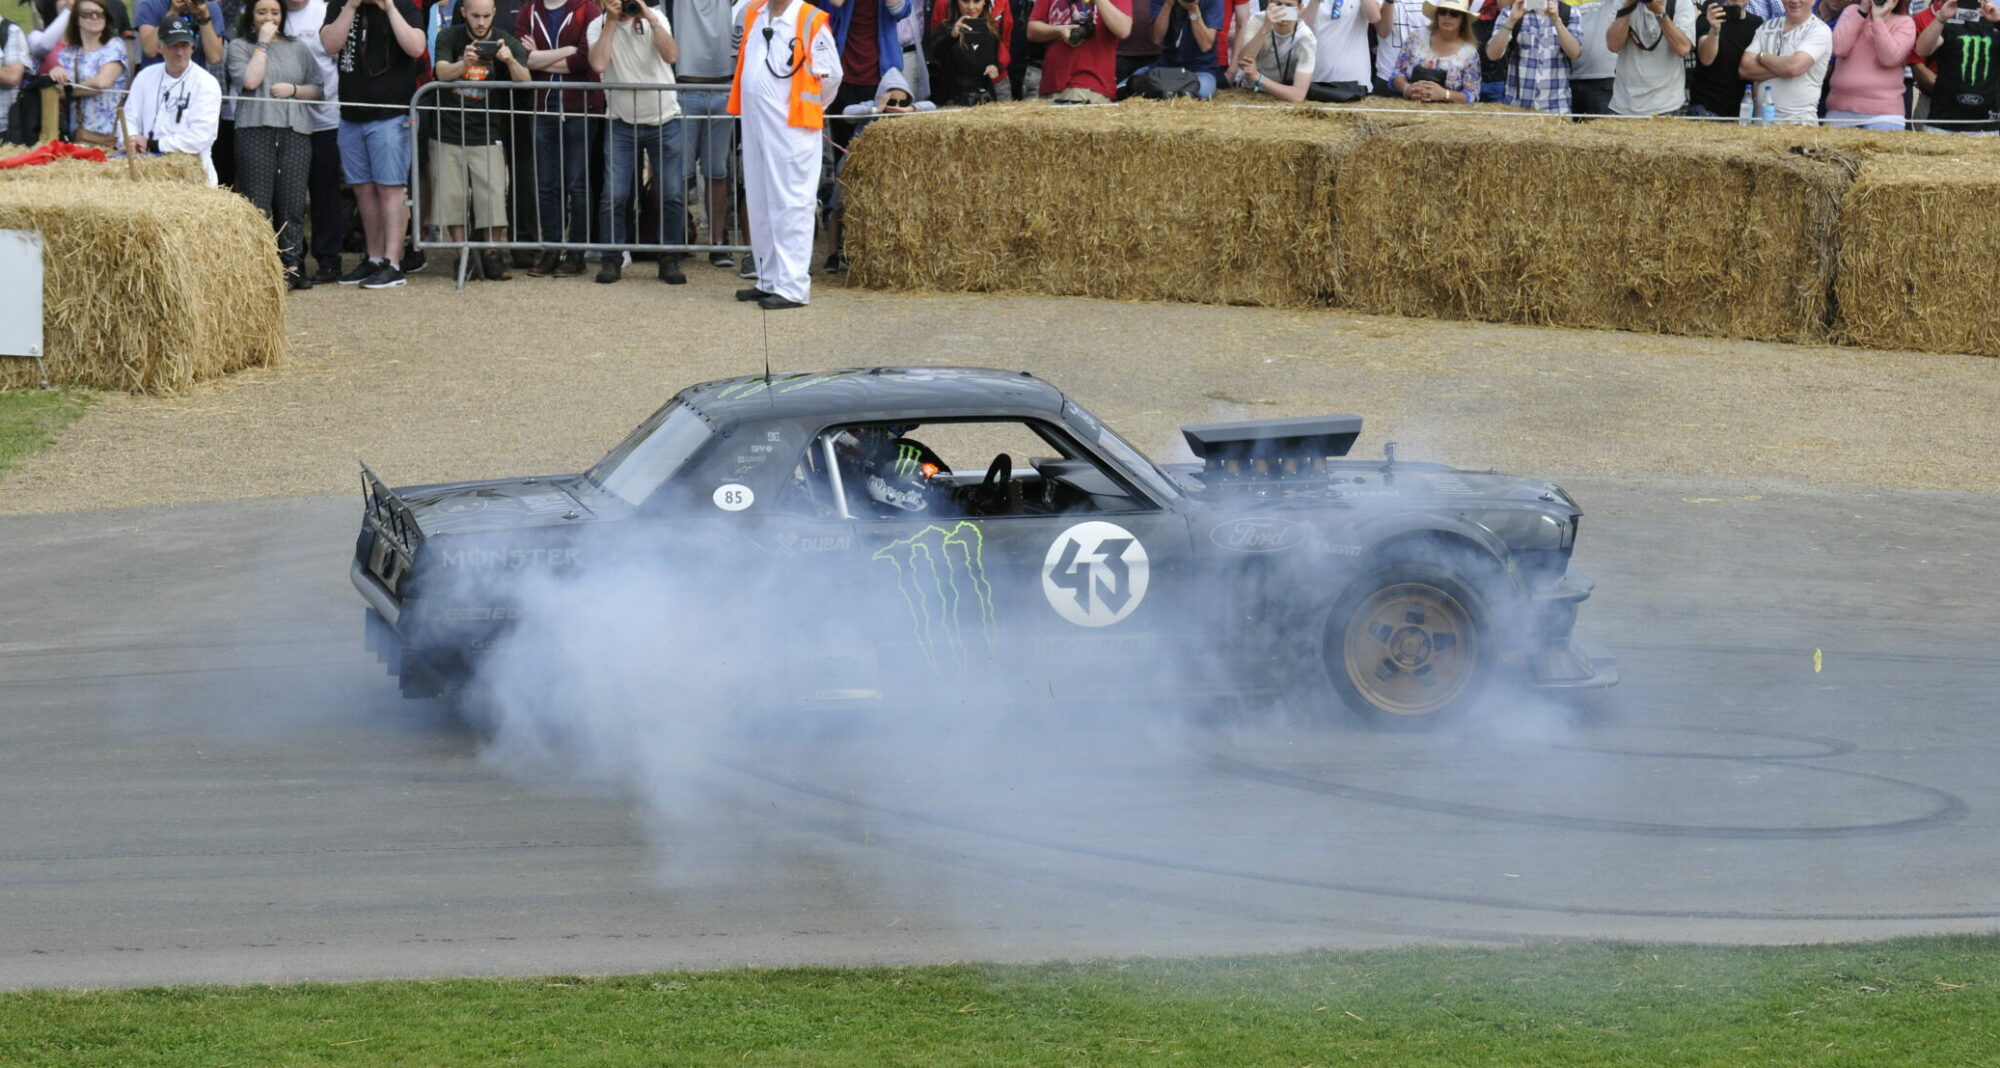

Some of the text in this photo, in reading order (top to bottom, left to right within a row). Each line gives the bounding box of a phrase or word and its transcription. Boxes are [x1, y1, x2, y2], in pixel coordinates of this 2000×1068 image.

[725, 491, 742, 503] 85
[801, 536, 852, 552] DUBAI
[1228, 520, 1288, 547] Ford
[442, 545, 583, 571] MONSTER
[1049, 537, 1134, 616] 43
